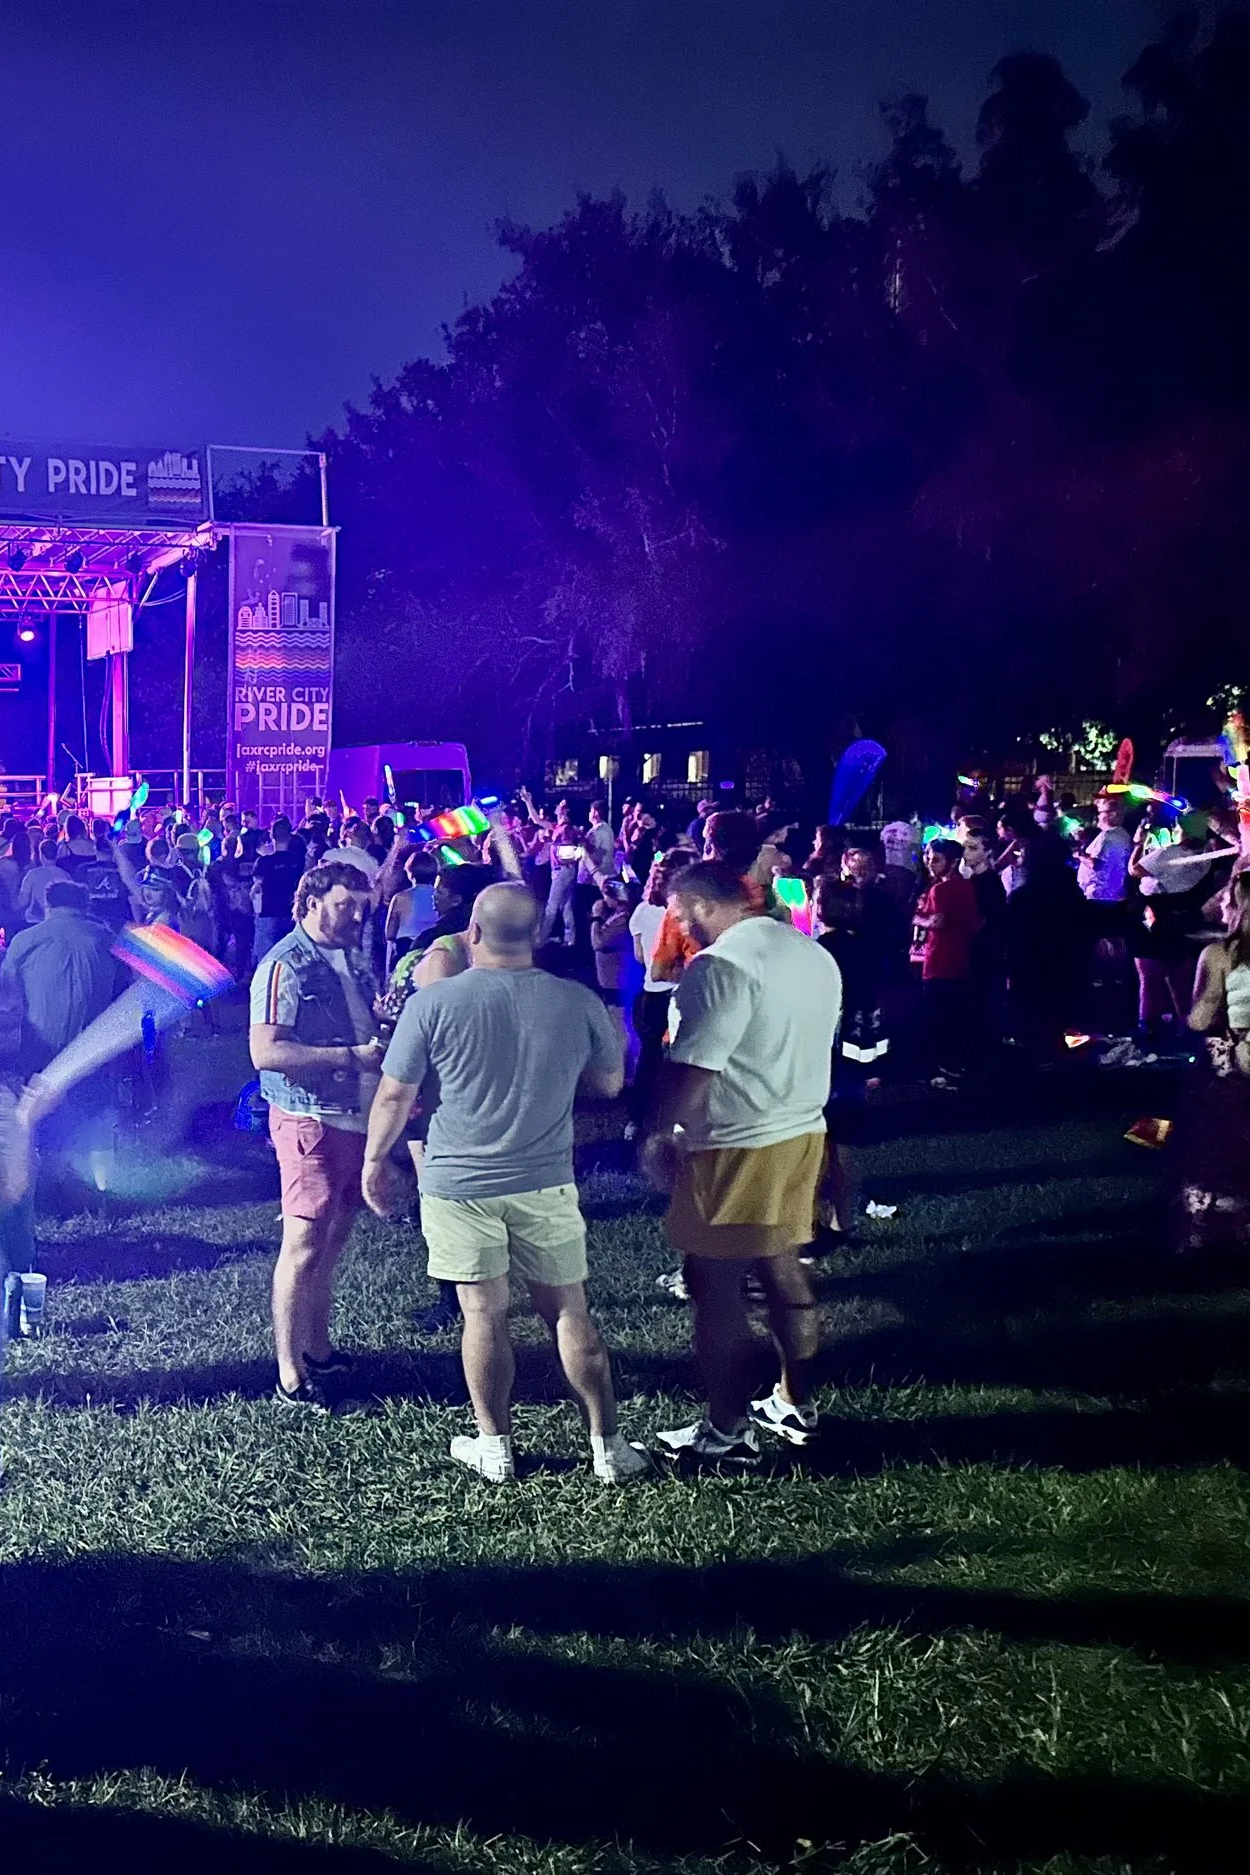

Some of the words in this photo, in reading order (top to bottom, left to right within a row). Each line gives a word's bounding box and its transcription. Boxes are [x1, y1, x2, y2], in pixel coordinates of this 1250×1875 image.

[47, 458, 137, 497] PRIDE
[235, 686, 286, 702] RIVER
[291, 686, 329, 702] CITY
[234, 702, 329, 731] PRIDE
[236, 742, 326, 758] jaxrcpride.org
[245, 759, 317, 775] #jaxrcpride
